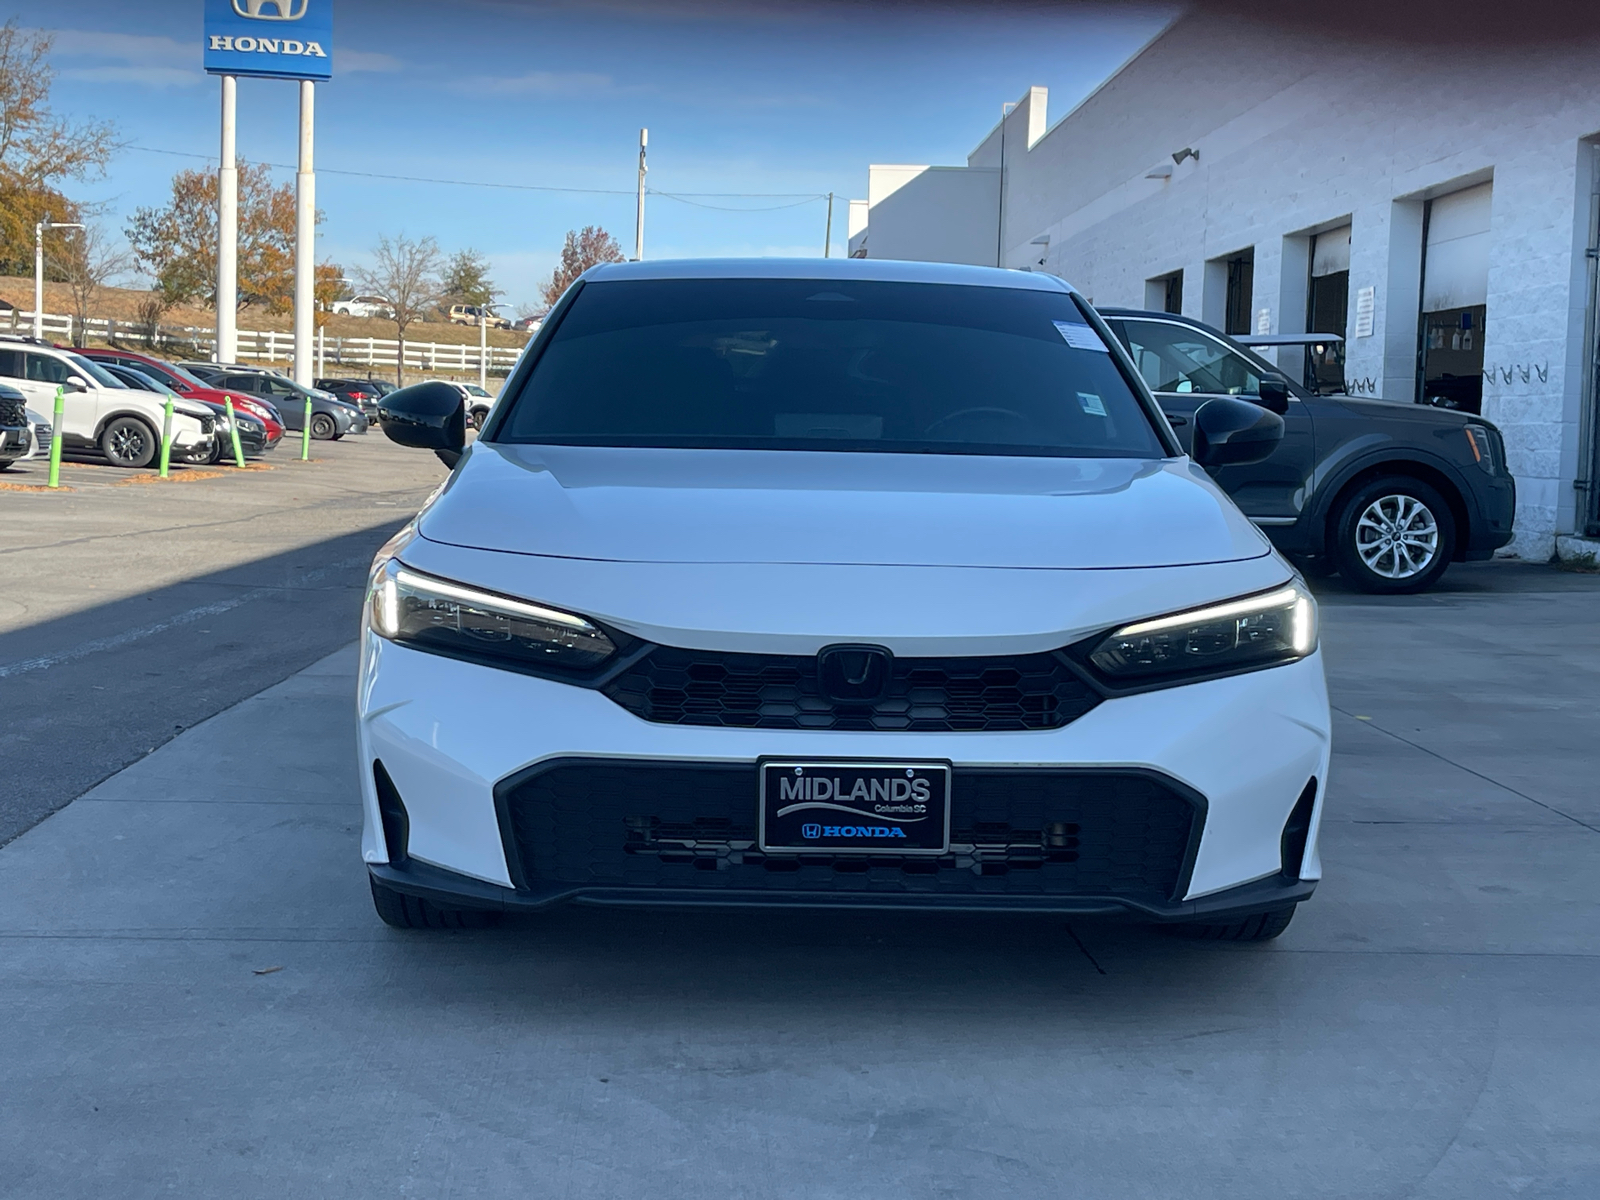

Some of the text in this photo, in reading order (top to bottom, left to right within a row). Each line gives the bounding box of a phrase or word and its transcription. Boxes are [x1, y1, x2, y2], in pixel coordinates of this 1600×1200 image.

[209, 35, 328, 58] HONDA
[780, 777, 931, 802] MIDLANDS
[822, 825, 907, 838] HONDA
